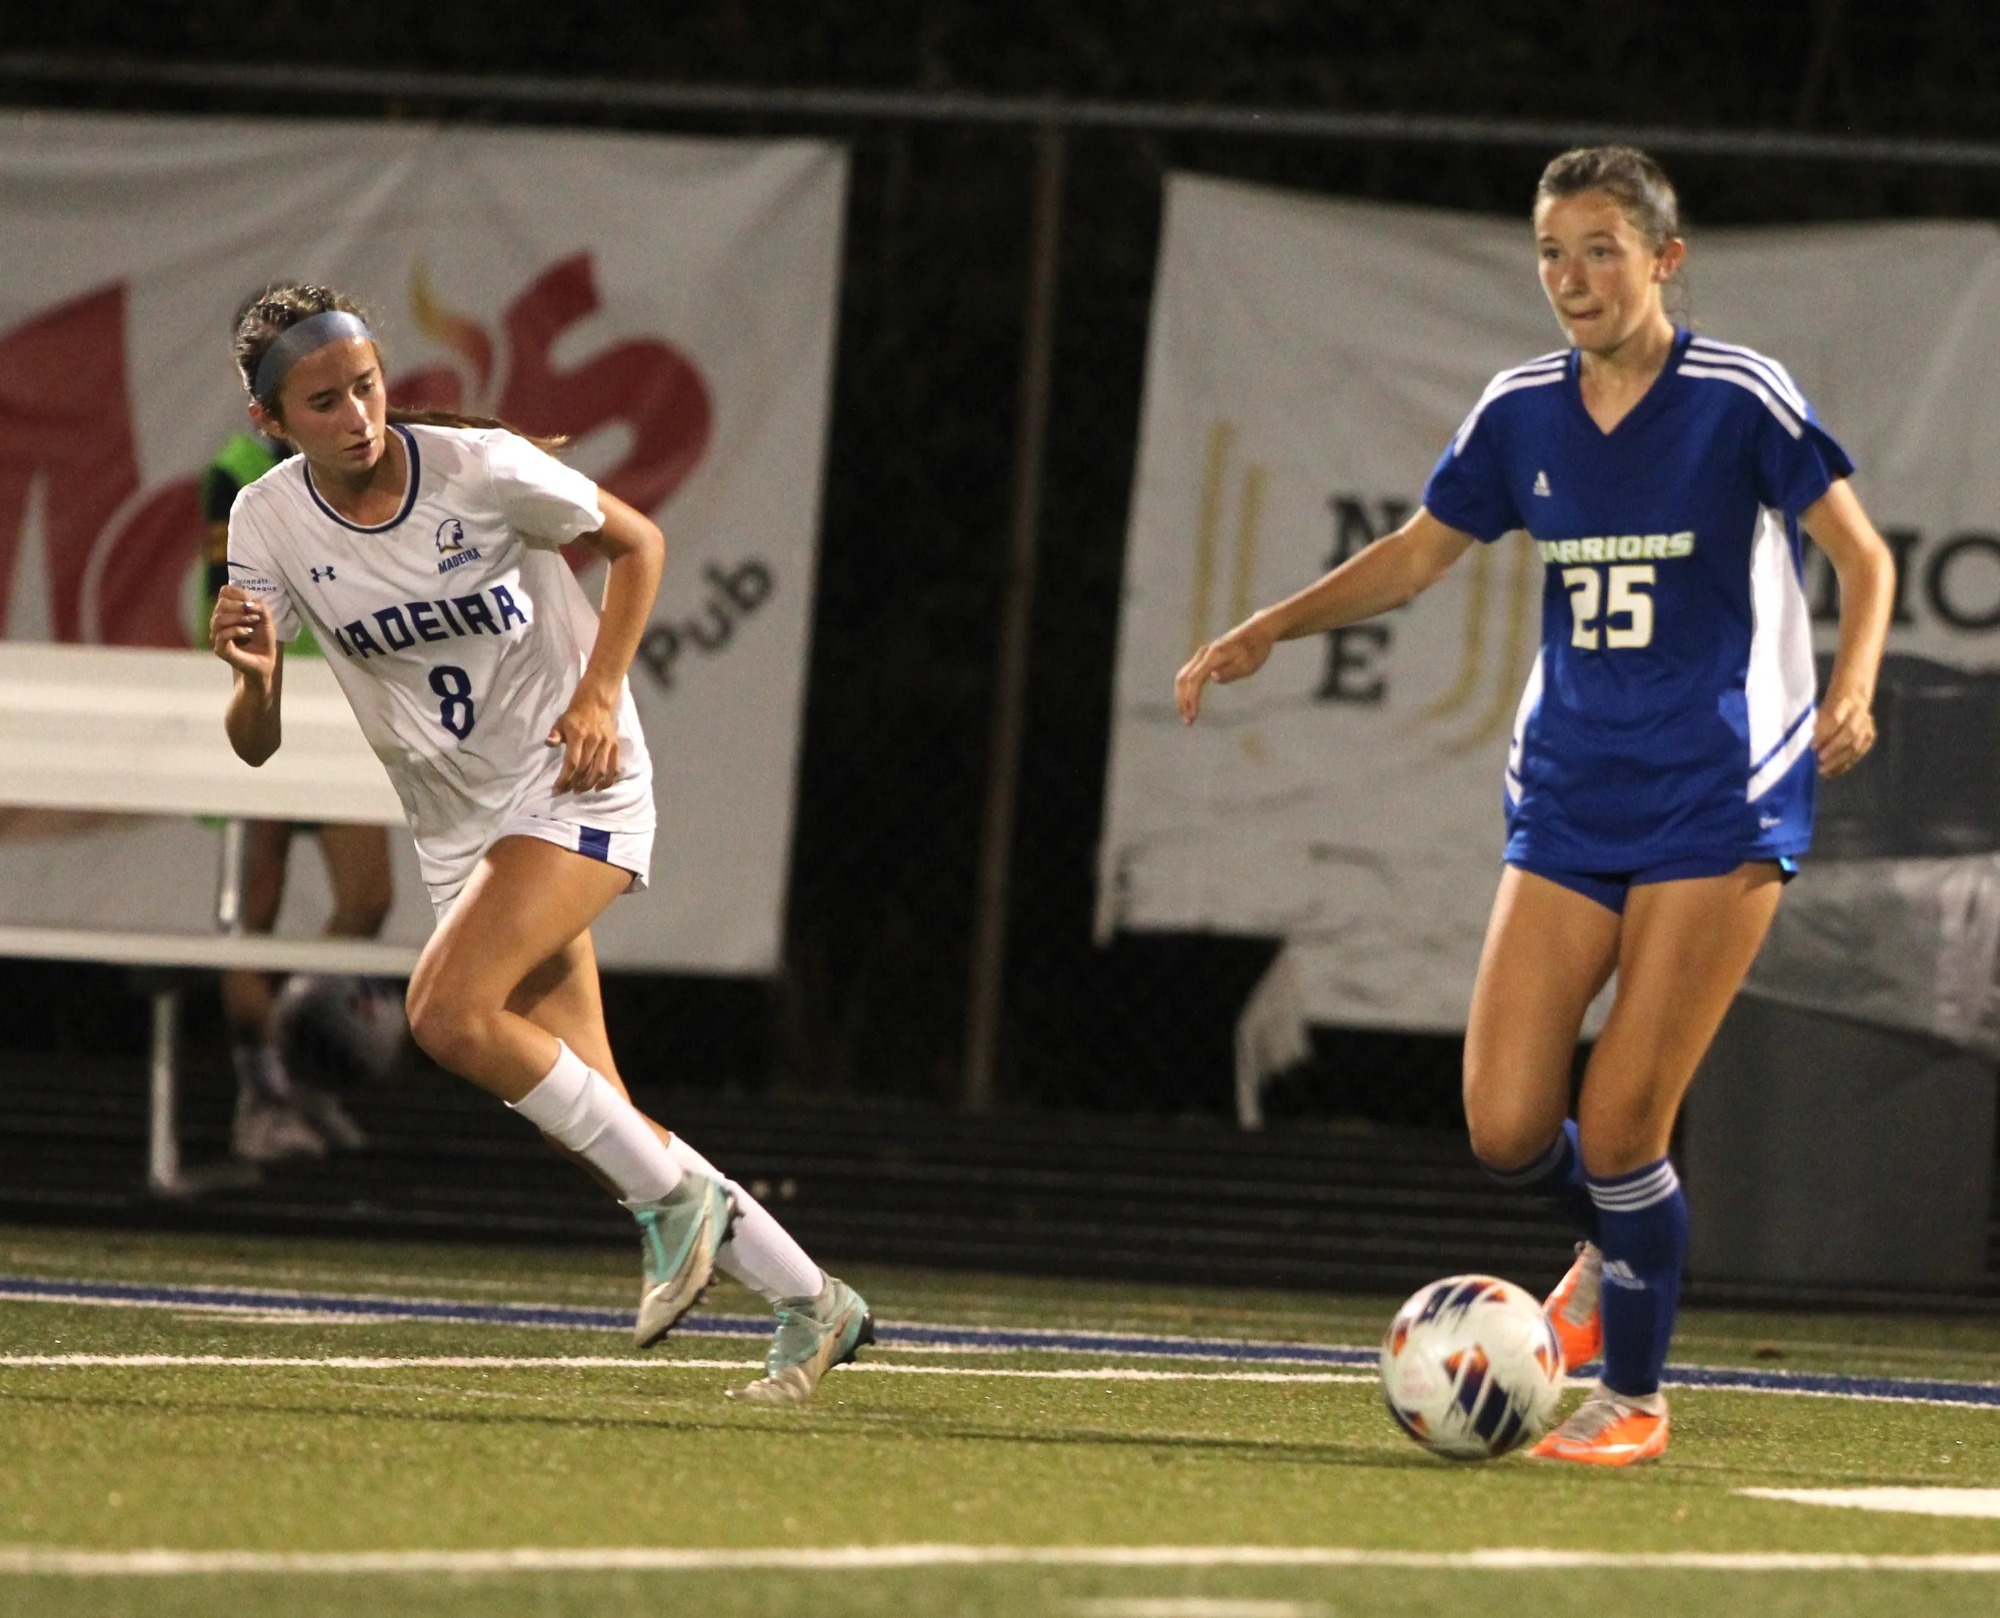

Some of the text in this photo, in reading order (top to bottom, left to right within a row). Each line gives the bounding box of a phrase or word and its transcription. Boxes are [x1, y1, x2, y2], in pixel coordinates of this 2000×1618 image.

[437, 547, 482, 575] MADEIRA
[638, 557, 774, 691] Pub
[1561, 564, 1656, 650] 25
[428, 665, 476, 741] 8
